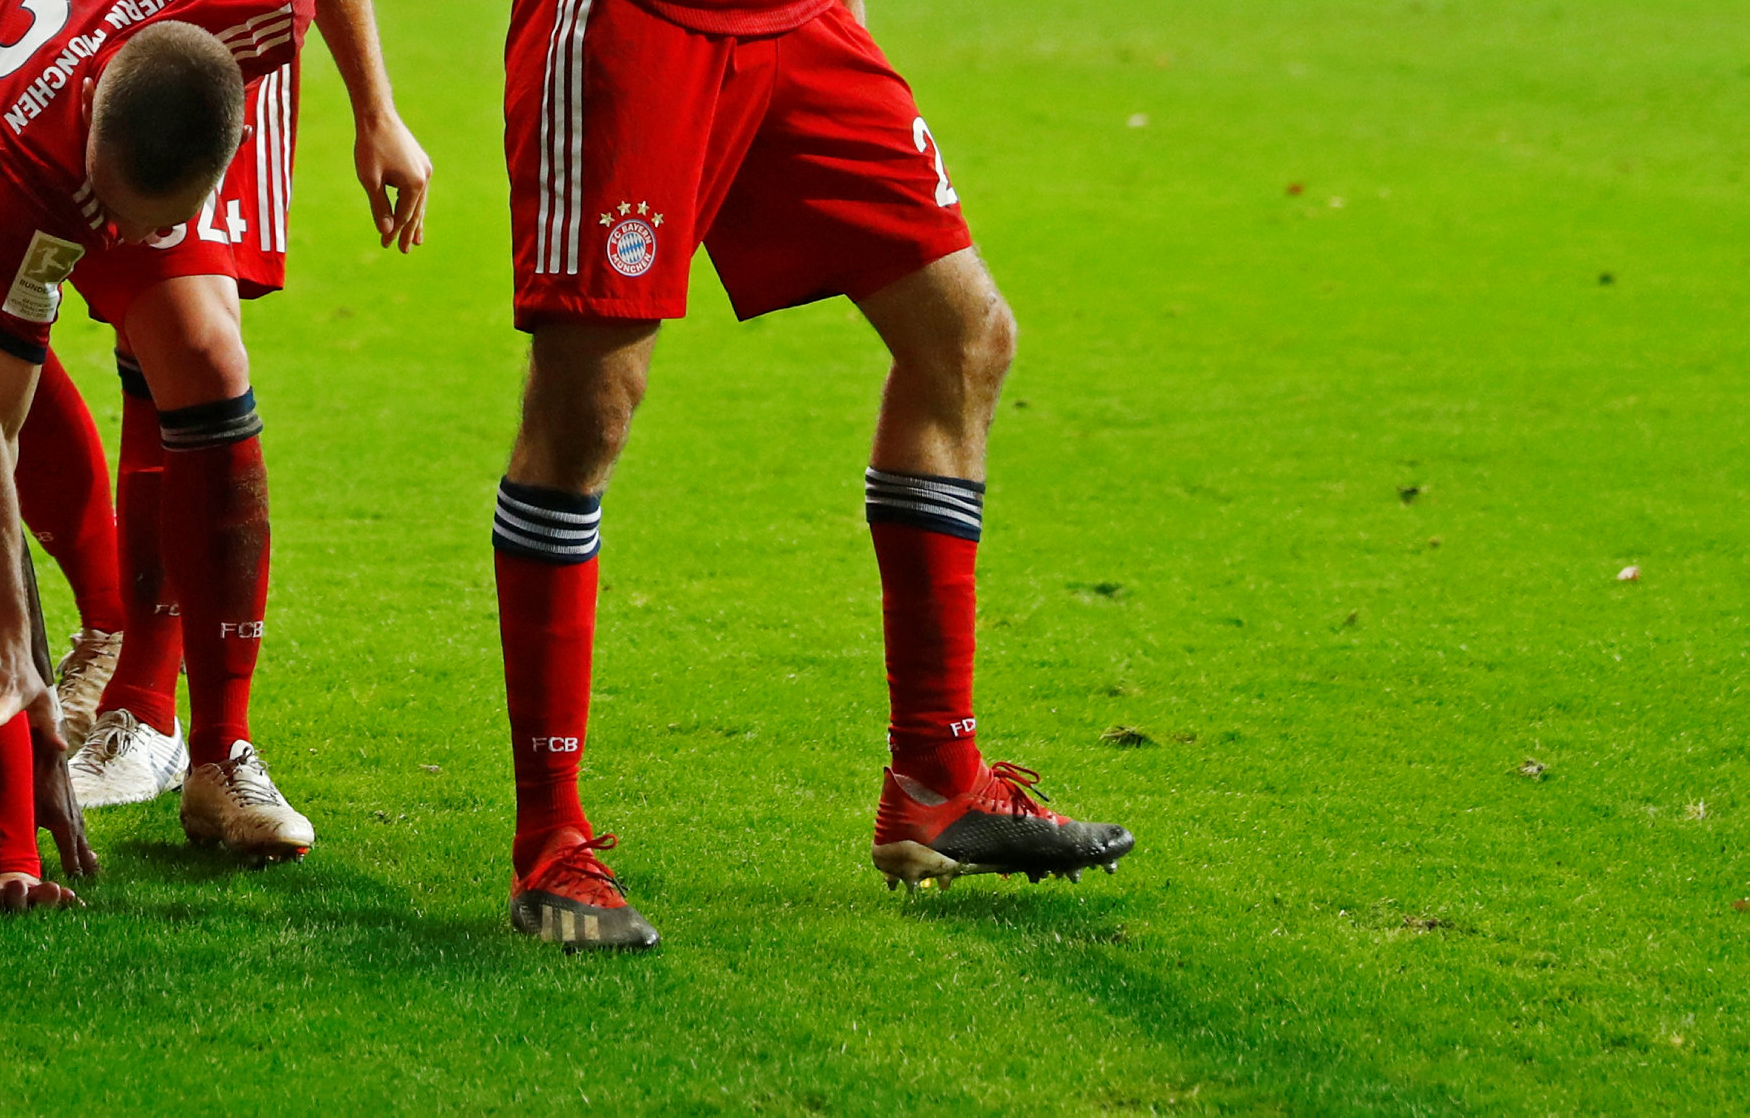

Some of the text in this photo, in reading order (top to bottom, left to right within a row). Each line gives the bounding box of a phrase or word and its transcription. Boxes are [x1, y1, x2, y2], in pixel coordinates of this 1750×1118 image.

[3, 28, 107, 135] MÜNCHEN
[621, 223, 652, 244] BAYERN
[154, 603, 181, 616] FC
[220, 620, 264, 639] FCB
[531, 736, 579, 752] FCB
